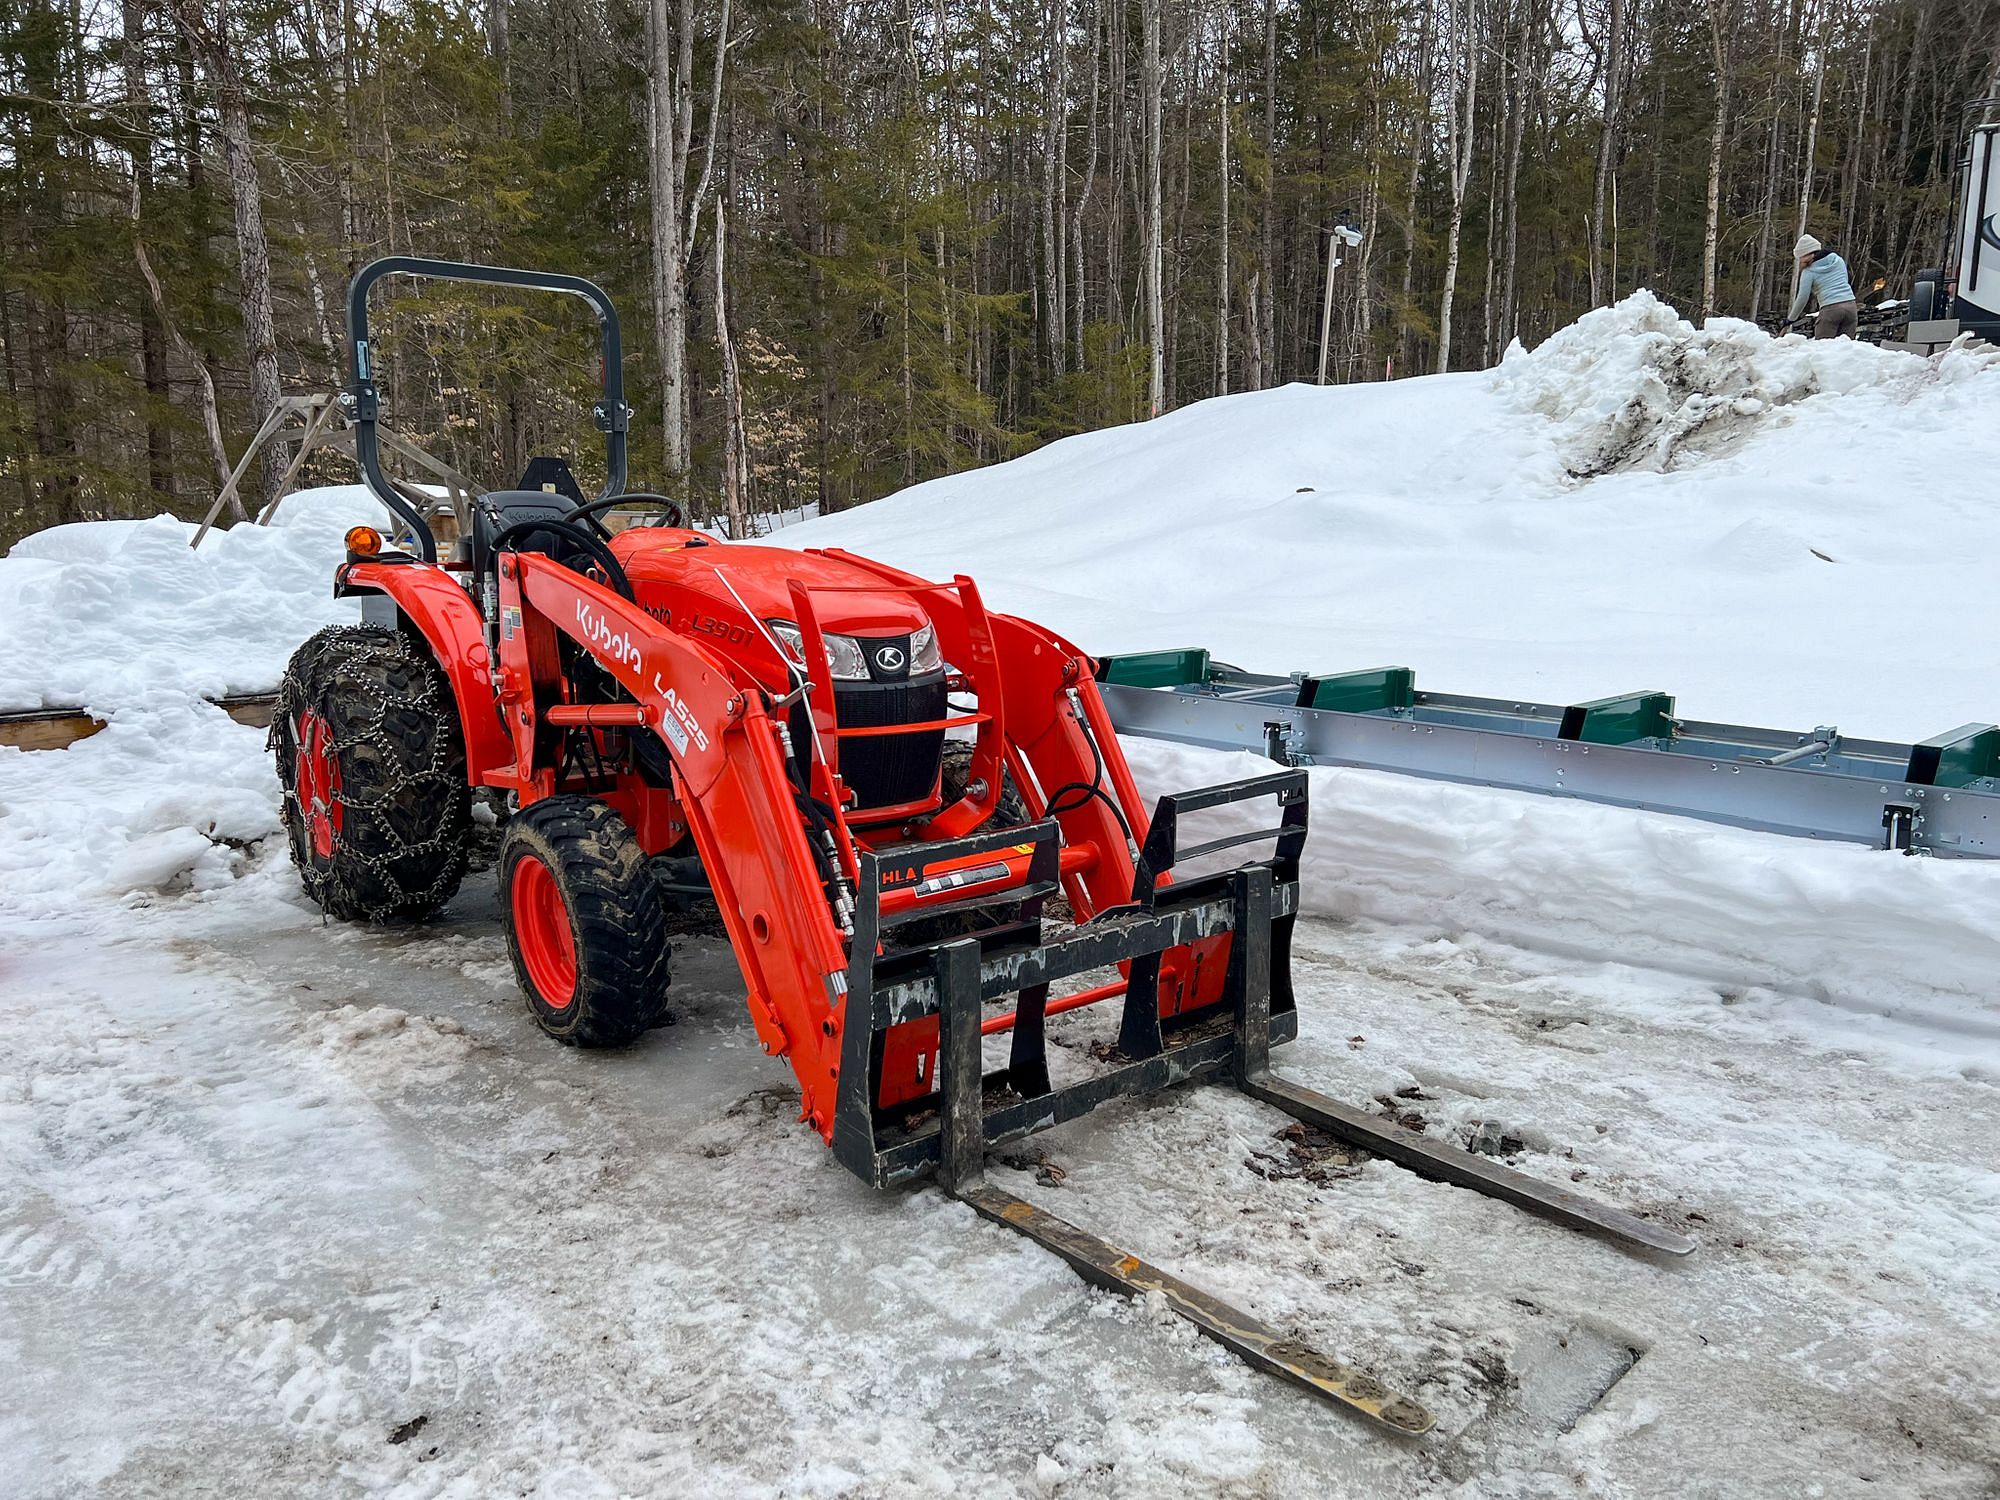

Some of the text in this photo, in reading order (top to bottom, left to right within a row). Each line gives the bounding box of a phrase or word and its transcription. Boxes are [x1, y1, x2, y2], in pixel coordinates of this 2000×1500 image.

[643, 600, 755, 647] bota L3901
[575, 598, 709, 752] Kubota LA525
[1281, 787, 1304, 802] HLA
[882, 867, 917, 885] HLA
